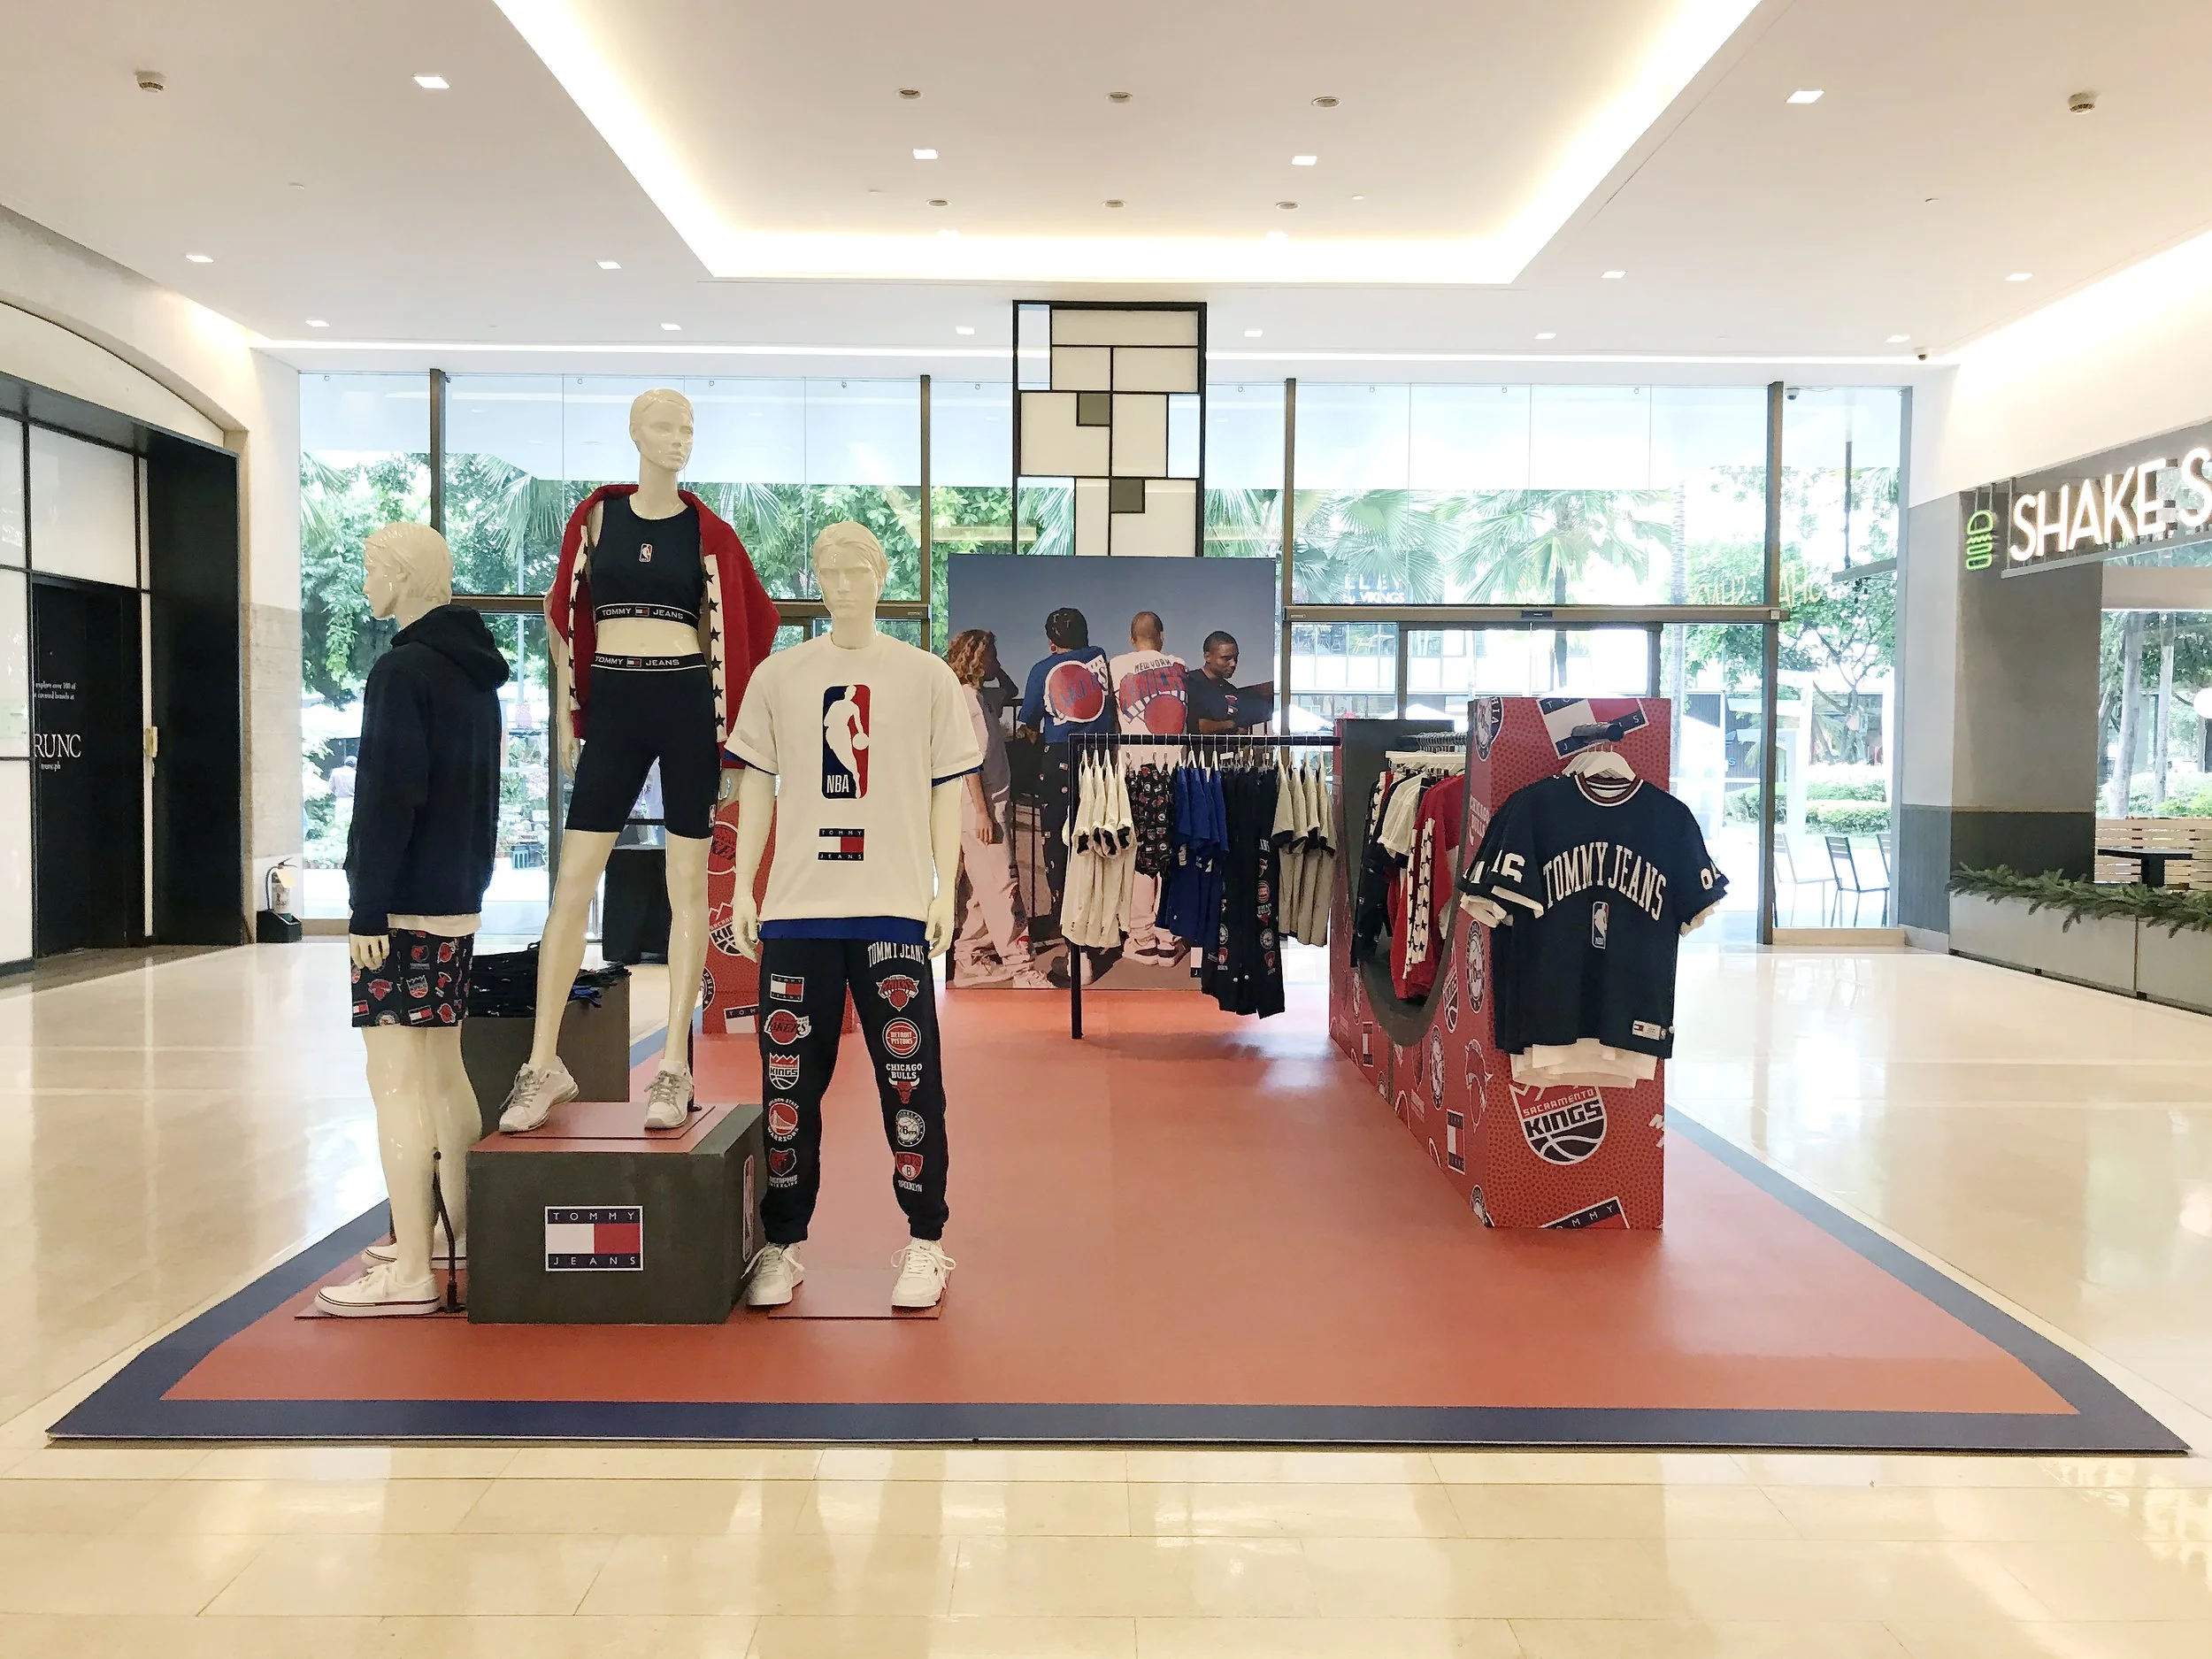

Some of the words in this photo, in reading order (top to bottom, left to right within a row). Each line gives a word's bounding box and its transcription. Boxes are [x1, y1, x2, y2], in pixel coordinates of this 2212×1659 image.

[2008, 457, 2167, 562] SHAKE
[1359, 592, 1405, 604] VIKINGS
[602, 608, 632, 617] TOMMY
[653, 609, 684, 619] JEANS
[595, 656, 624, 665] TOMMY
[1134, 662, 1149, 672] NEW
[1149, 658, 1172, 669] YORK
[826, 774, 850, 794] NBA
[1542, 841, 1609, 910] TOMMY
[1608, 844, 1667, 921] JEANS
[899, 943, 925, 965] JEANS
[1523, 1088, 1594, 1117] SACRAMENTO
[1524, 1099, 1603, 1139] KINGS
[898, 1179, 923, 1193] BROOKLYN
[552, 1211, 635, 1222] TOMMY
[552, 1256, 636, 1266] JEANS
